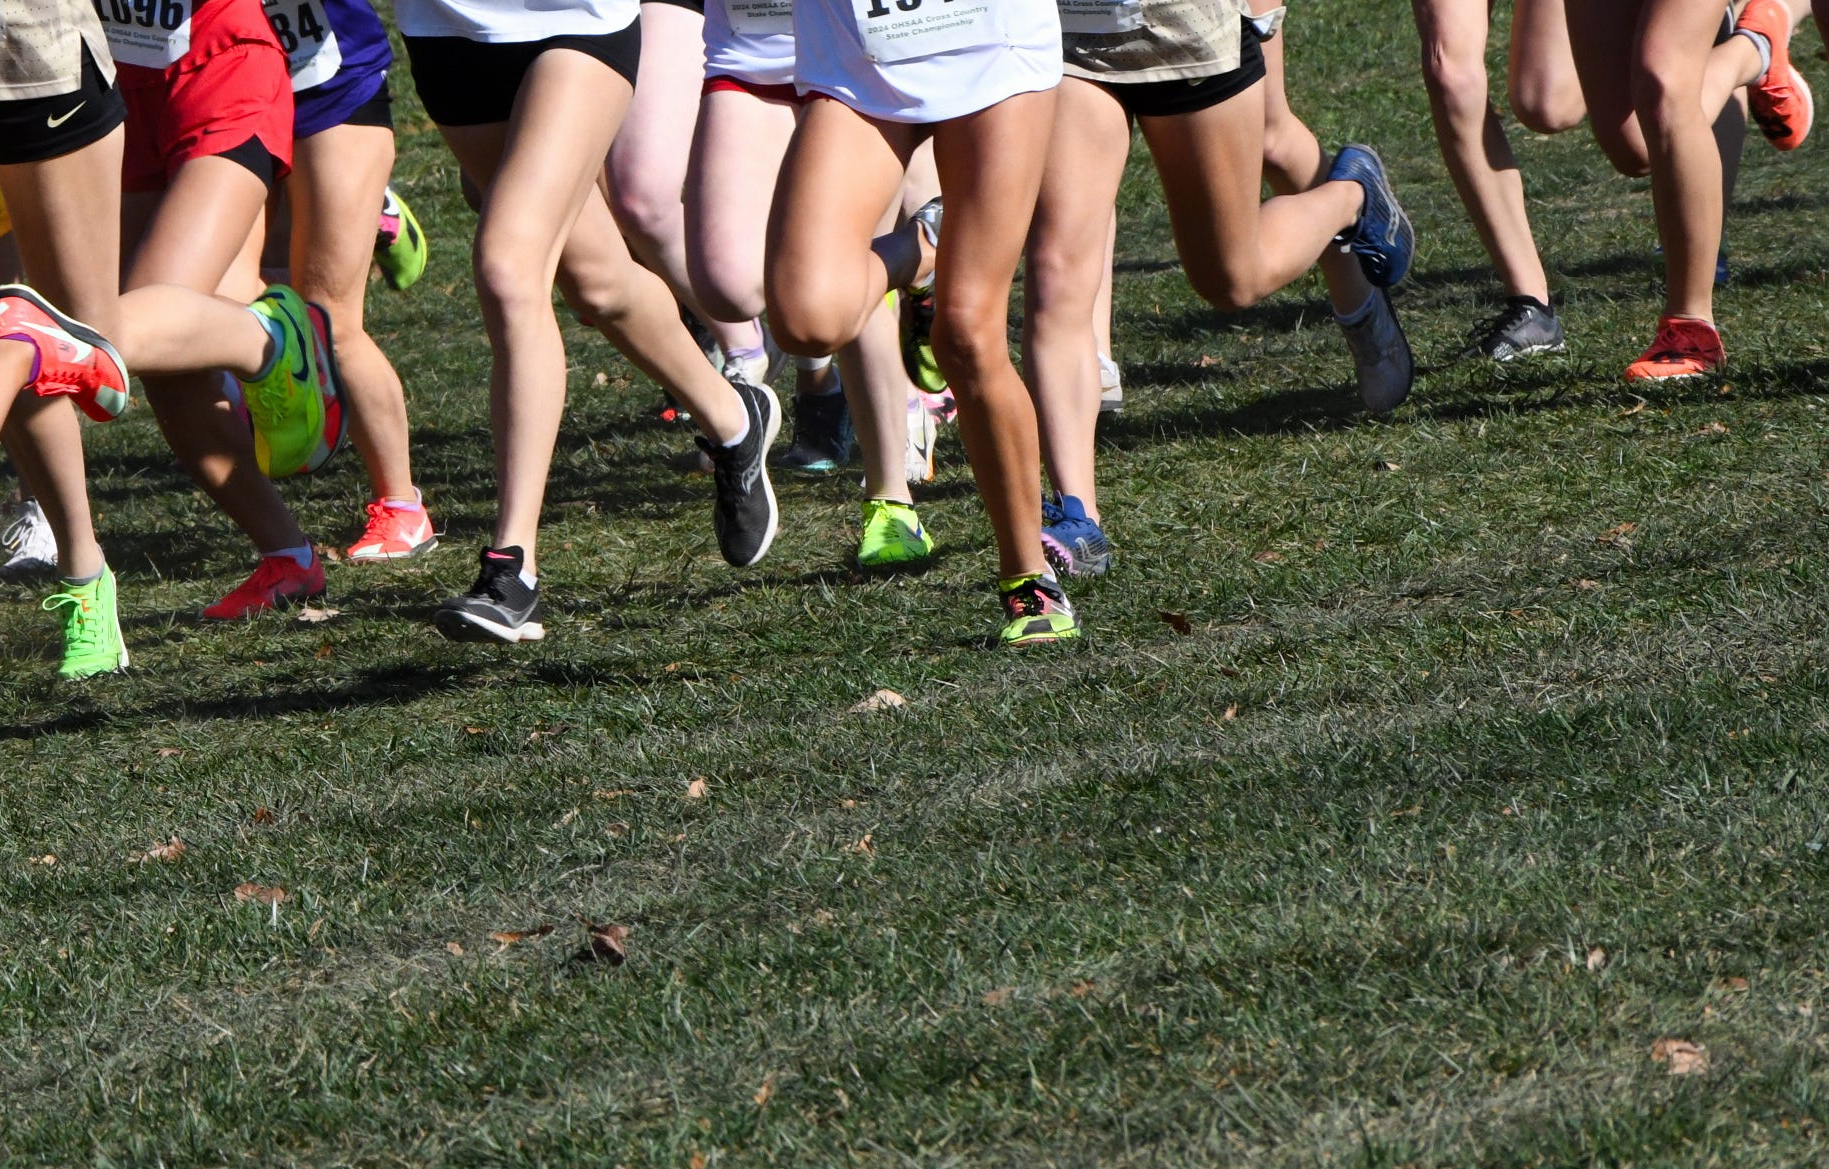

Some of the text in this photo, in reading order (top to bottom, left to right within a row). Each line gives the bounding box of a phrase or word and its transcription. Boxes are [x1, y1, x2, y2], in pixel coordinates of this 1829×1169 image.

[269, 2, 324, 53] 84
[867, 5, 989, 35] 2024 OHSAA Cross Country
[885, 18, 974, 41] State Championship
